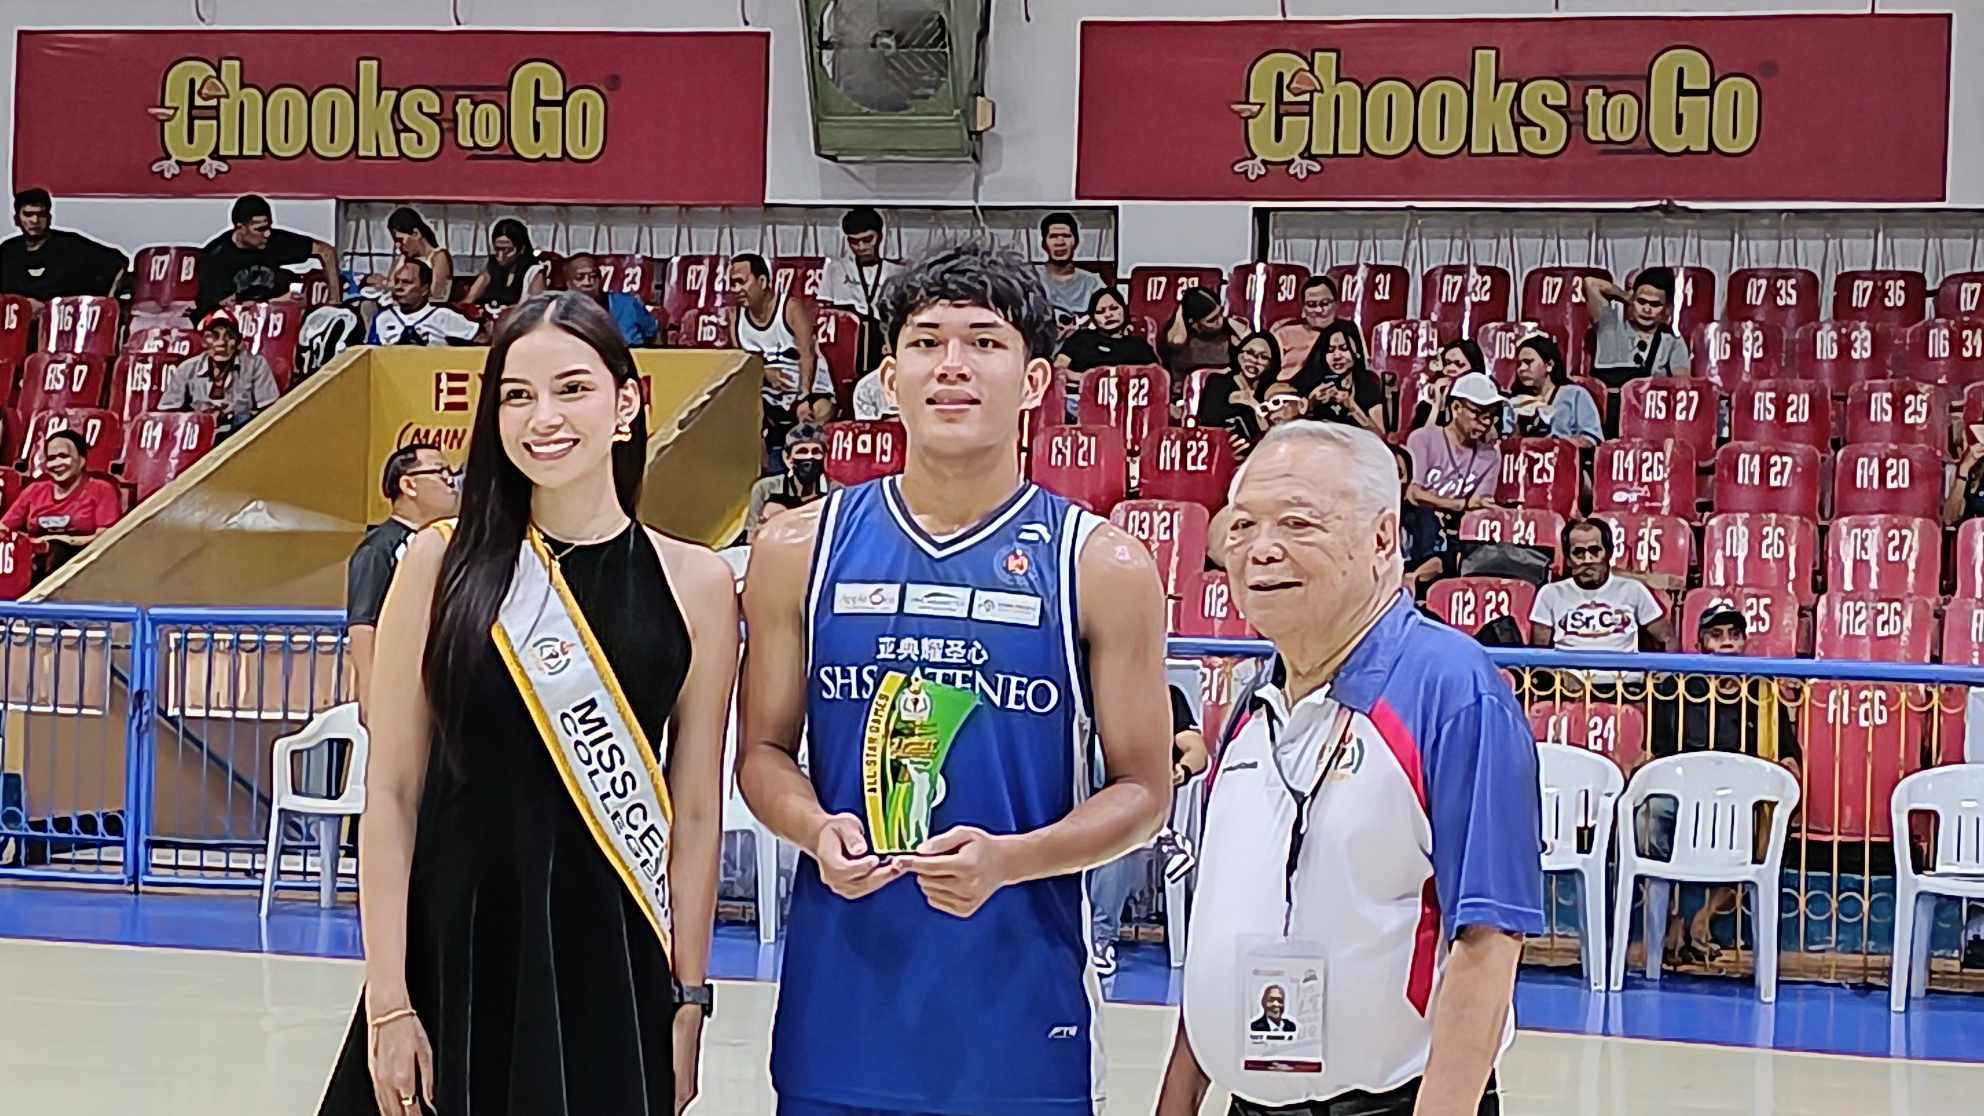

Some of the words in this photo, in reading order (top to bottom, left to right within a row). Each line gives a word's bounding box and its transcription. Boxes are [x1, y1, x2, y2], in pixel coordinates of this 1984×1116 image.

[161, 57, 441, 163] Chooks
[456, 97, 501, 149] to
[509, 58, 608, 161] Go
[1246, 47, 1570, 162] Chooks
[1584, 86, 1640, 144] to
[1648, 45, 1762, 156] Go
[1374, 273, 1391, 300] 31
[1572, 277, 1585, 302] 3
[1776, 278, 1798, 306] 35
[1884, 280, 1906, 308] 36
[1675, 390, 1699, 421] 27
[875, 431, 894, 463] 19
[1186, 438, 1209, 471] 22
[1533, 451, 1556, 484] 25
[1642, 450, 1665, 483] 26
[1769, 455, 1793, 487] 27
[1761, 526, 1785, 559] 26
[1887, 529, 1913, 562] 27
[1745, 597, 1772, 633] 25
[1876, 602, 1901, 638] 26
[820, 665, 879, 700] SHS
[571, 697, 637, 800] MISS
[1588, 715, 1616, 752] 24
